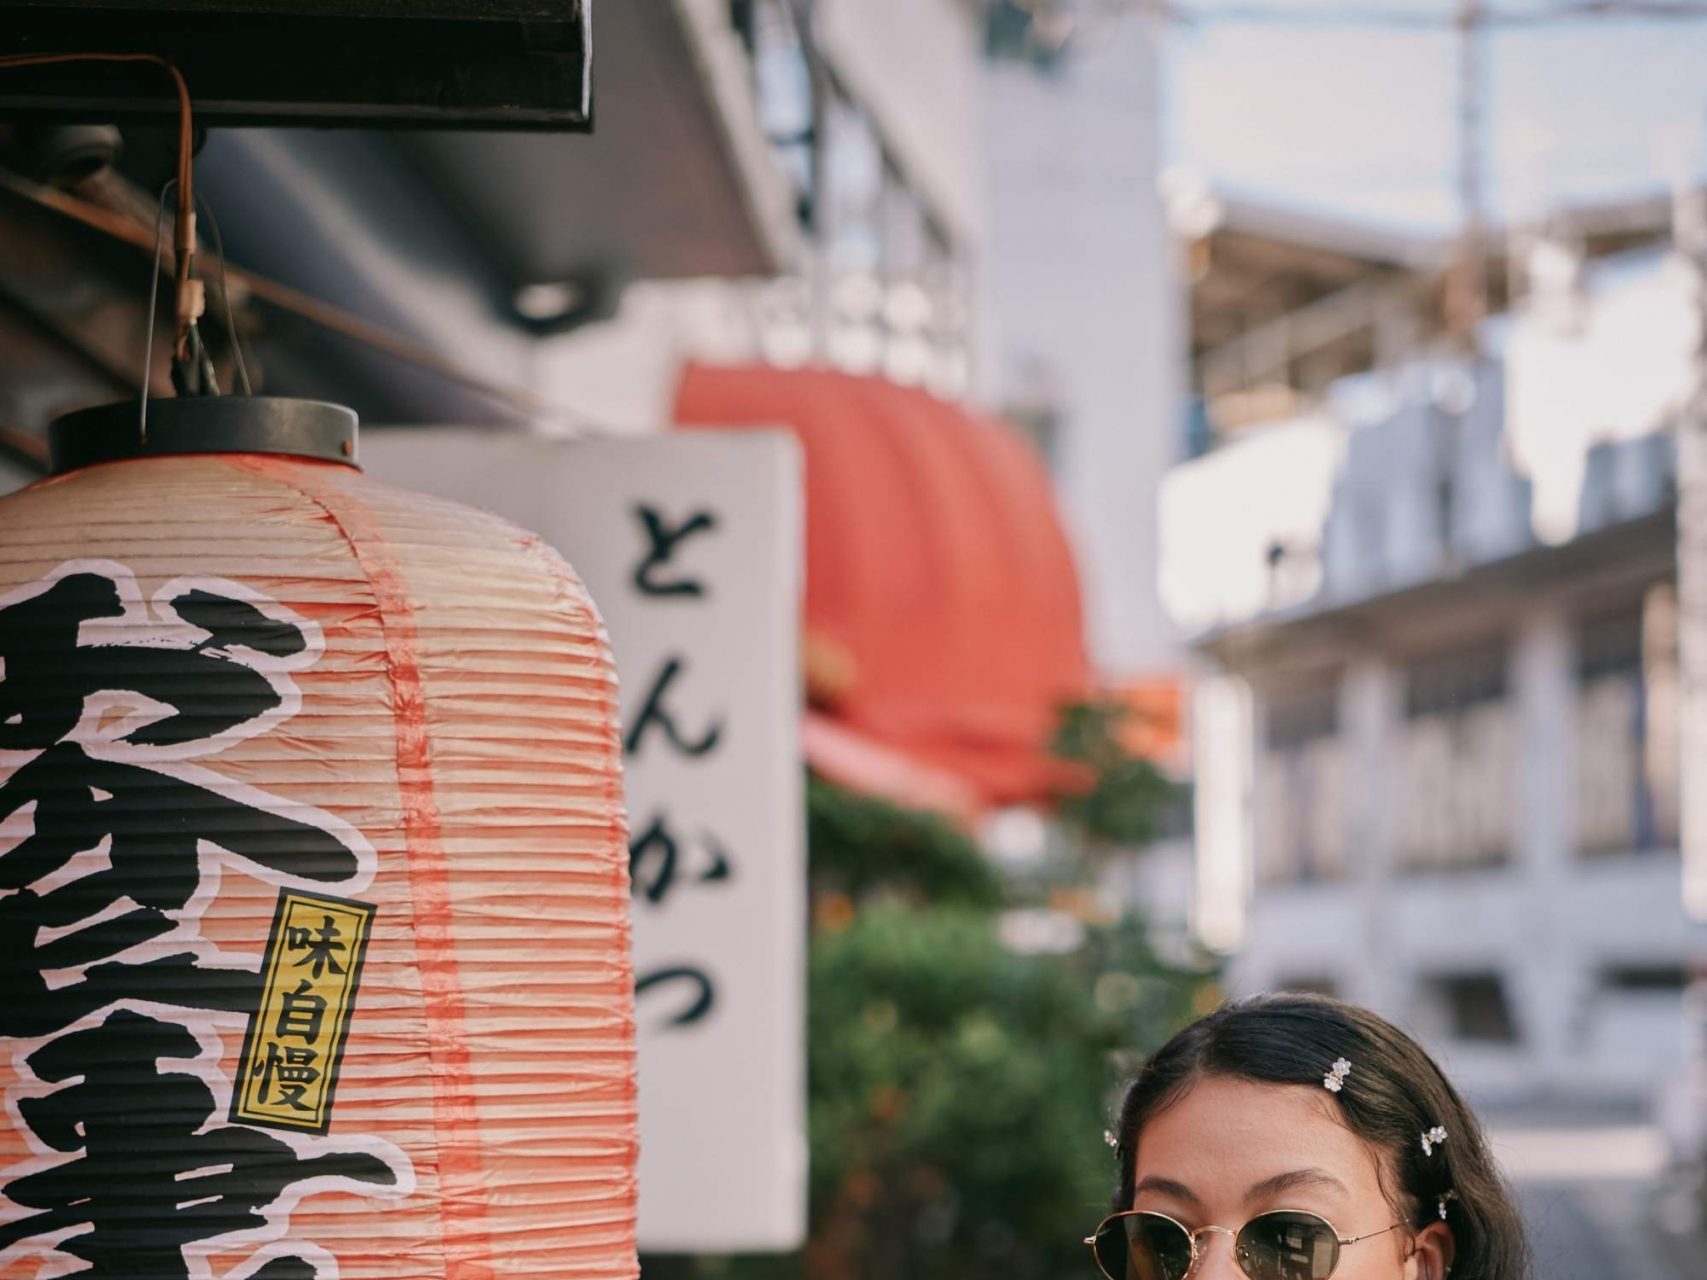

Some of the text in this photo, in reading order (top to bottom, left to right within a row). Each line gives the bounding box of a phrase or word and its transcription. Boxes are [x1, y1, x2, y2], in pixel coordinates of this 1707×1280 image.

[625, 502, 731, 1028] とんかつ
[254, 916, 347, 1112] 味自慢
